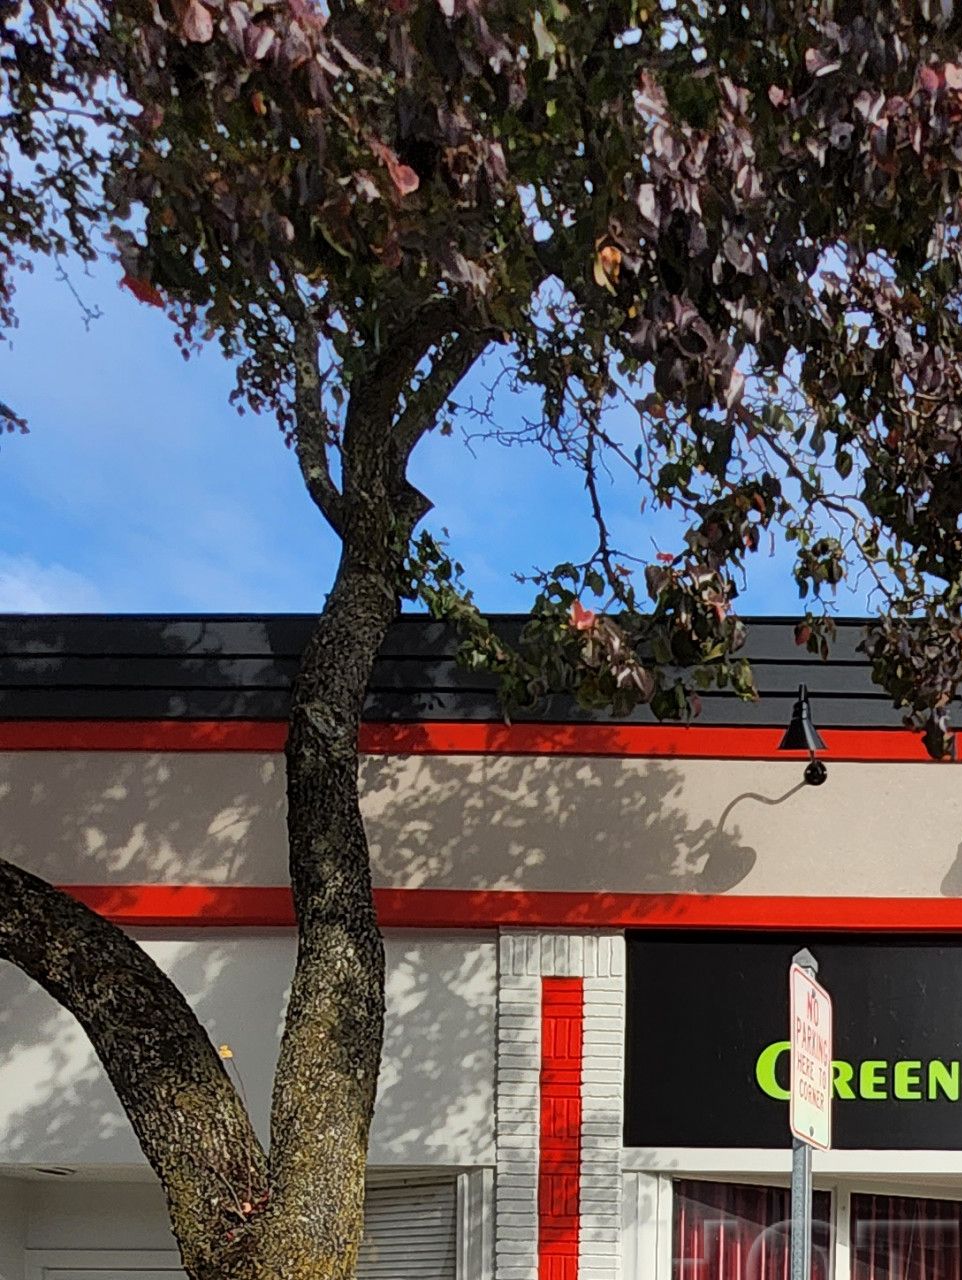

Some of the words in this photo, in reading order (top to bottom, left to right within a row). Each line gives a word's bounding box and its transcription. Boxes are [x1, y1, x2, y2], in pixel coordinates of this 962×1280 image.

[807, 991, 819, 1027] NO
[796, 1016, 828, 1067] PARKING
[797, 1050, 814, 1081] HERE
[818, 1066, 827, 1090] TO
[799, 1078, 824, 1112] CORNER
